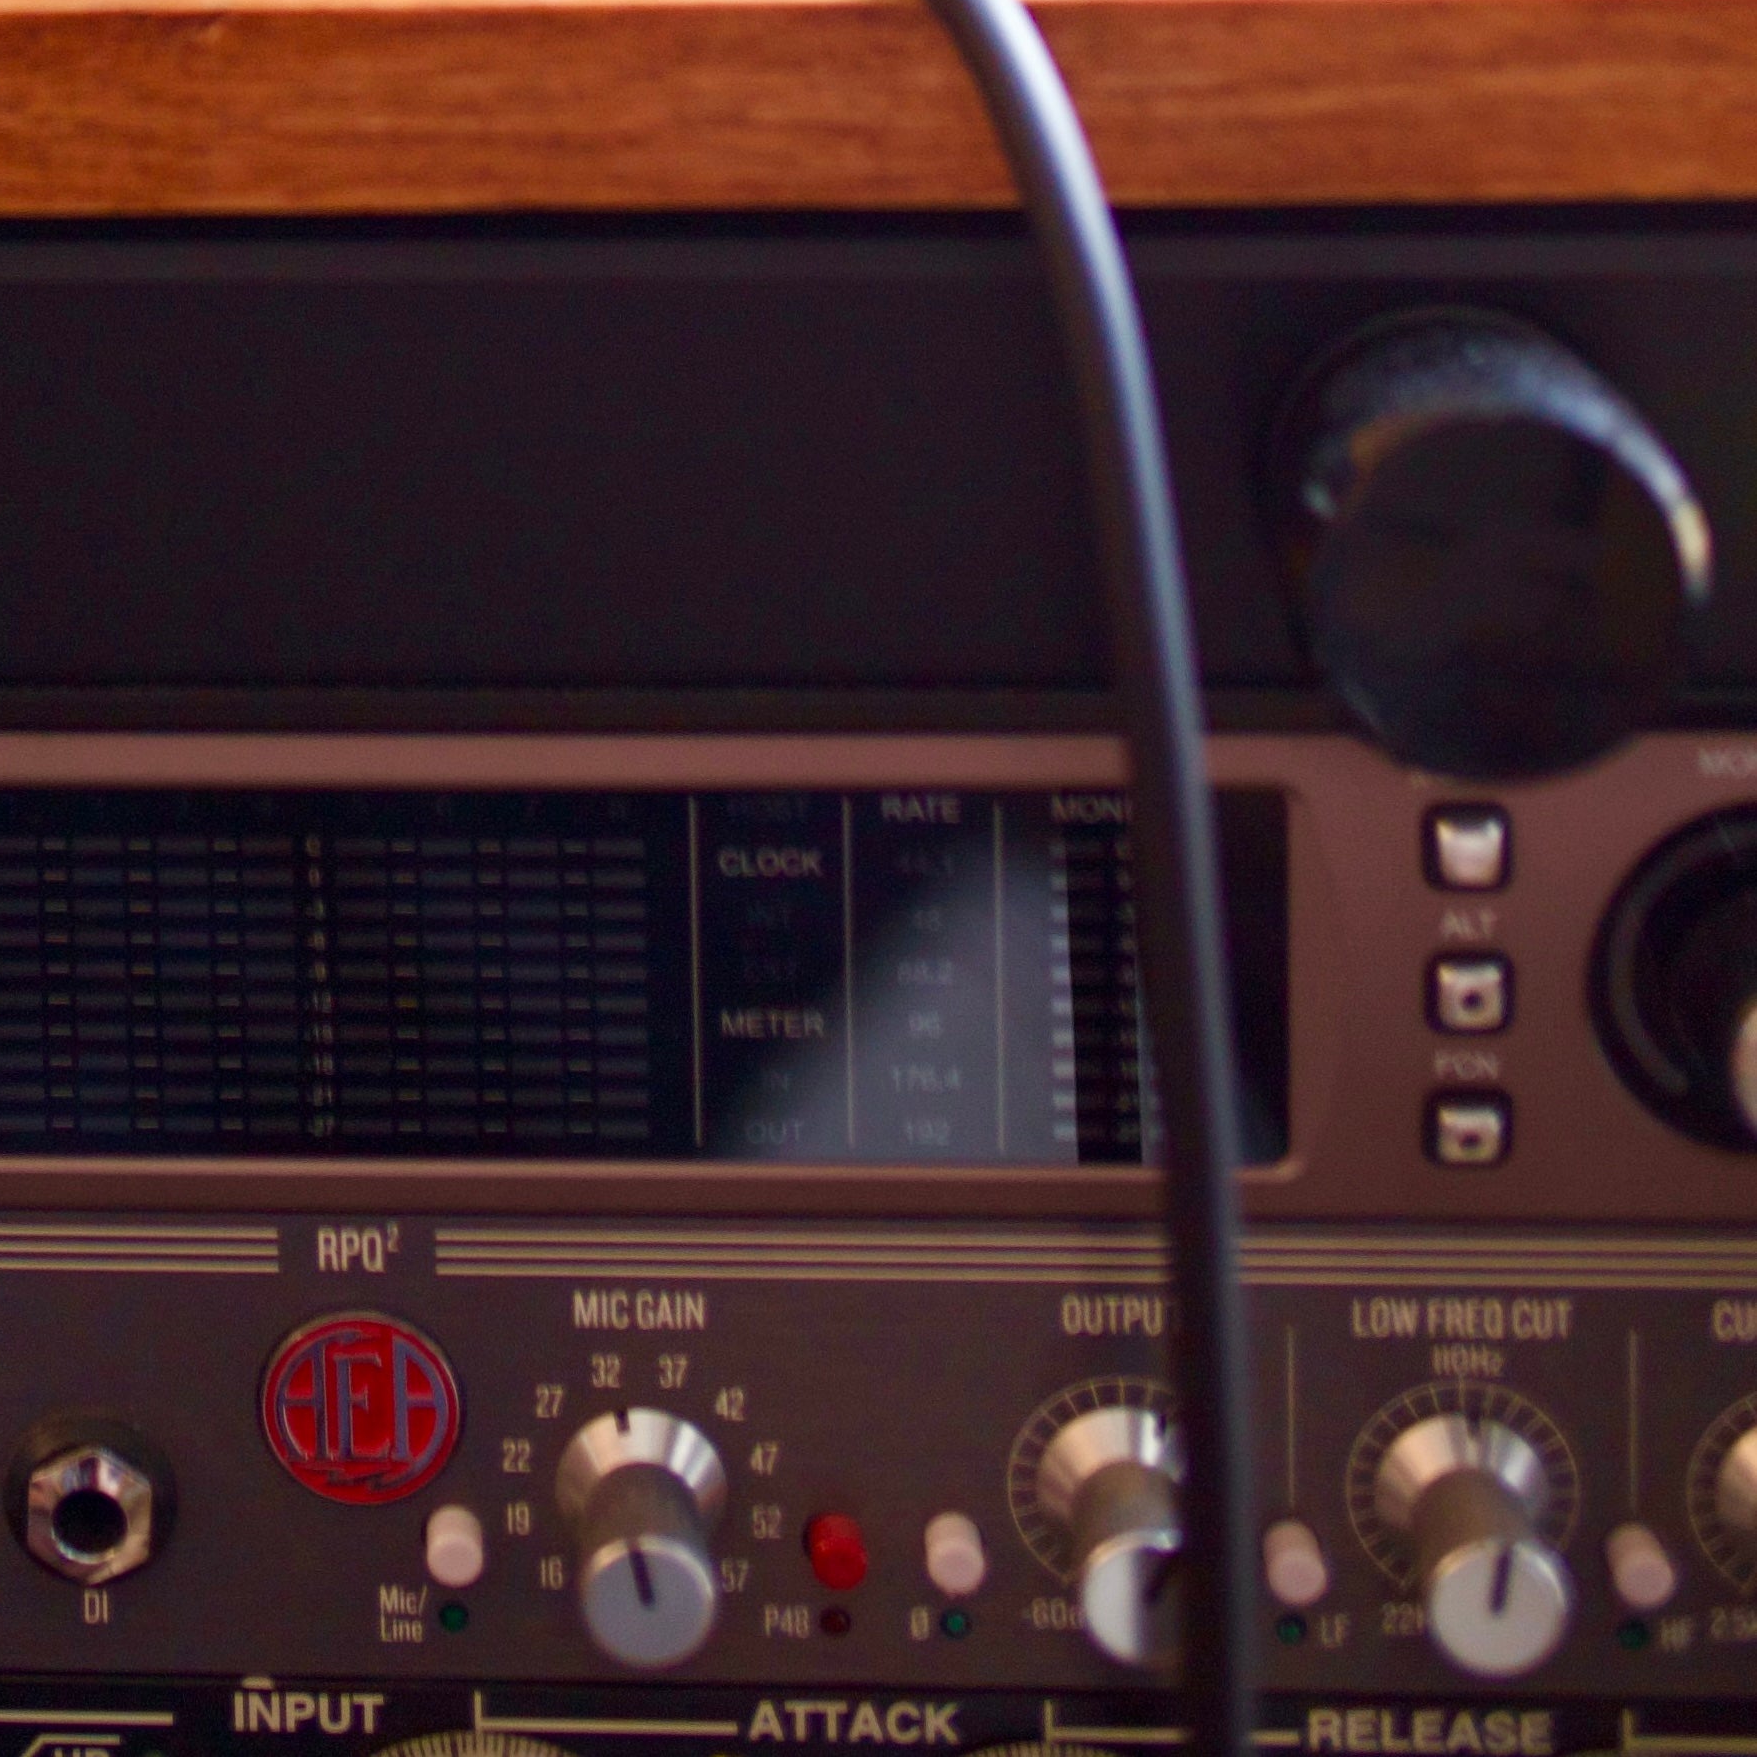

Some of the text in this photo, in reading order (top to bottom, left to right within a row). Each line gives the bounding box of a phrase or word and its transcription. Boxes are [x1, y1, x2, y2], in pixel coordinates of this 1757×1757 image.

[718, 848, 823, 878] CLOCK
[720, 1009, 825, 1038] METER
[573, 1290, 706, 1329] MIC GAIN
[1061, 1297, 1165, 1336] OUTPU
[1352, 1297, 1419, 1338] LOW
[1512, 1299, 1572, 1340] CUT
[591, 1355, 621, 1385] 32
[657, 1356, 687, 1386] 37
[535, 1387, 563, 1417] 27
[714, 1388, 744, 1420] 42
[502, 1441, 531, 1471] 22
[749, 1445, 778, 1475] 47
[504, 1504, 531, 1535] 19
[751, 1508, 782, 1539] 52
[83, 1589, 109, 1623] DI
[764, 1605, 810, 1638] P48
[380, 1617, 423, 1642] Line
[233, 1693, 384, 1734] INPUT
[748, 1701, 959, 1743] ATTACK
[1309, 1710, 1552, 1753] RELEASE
